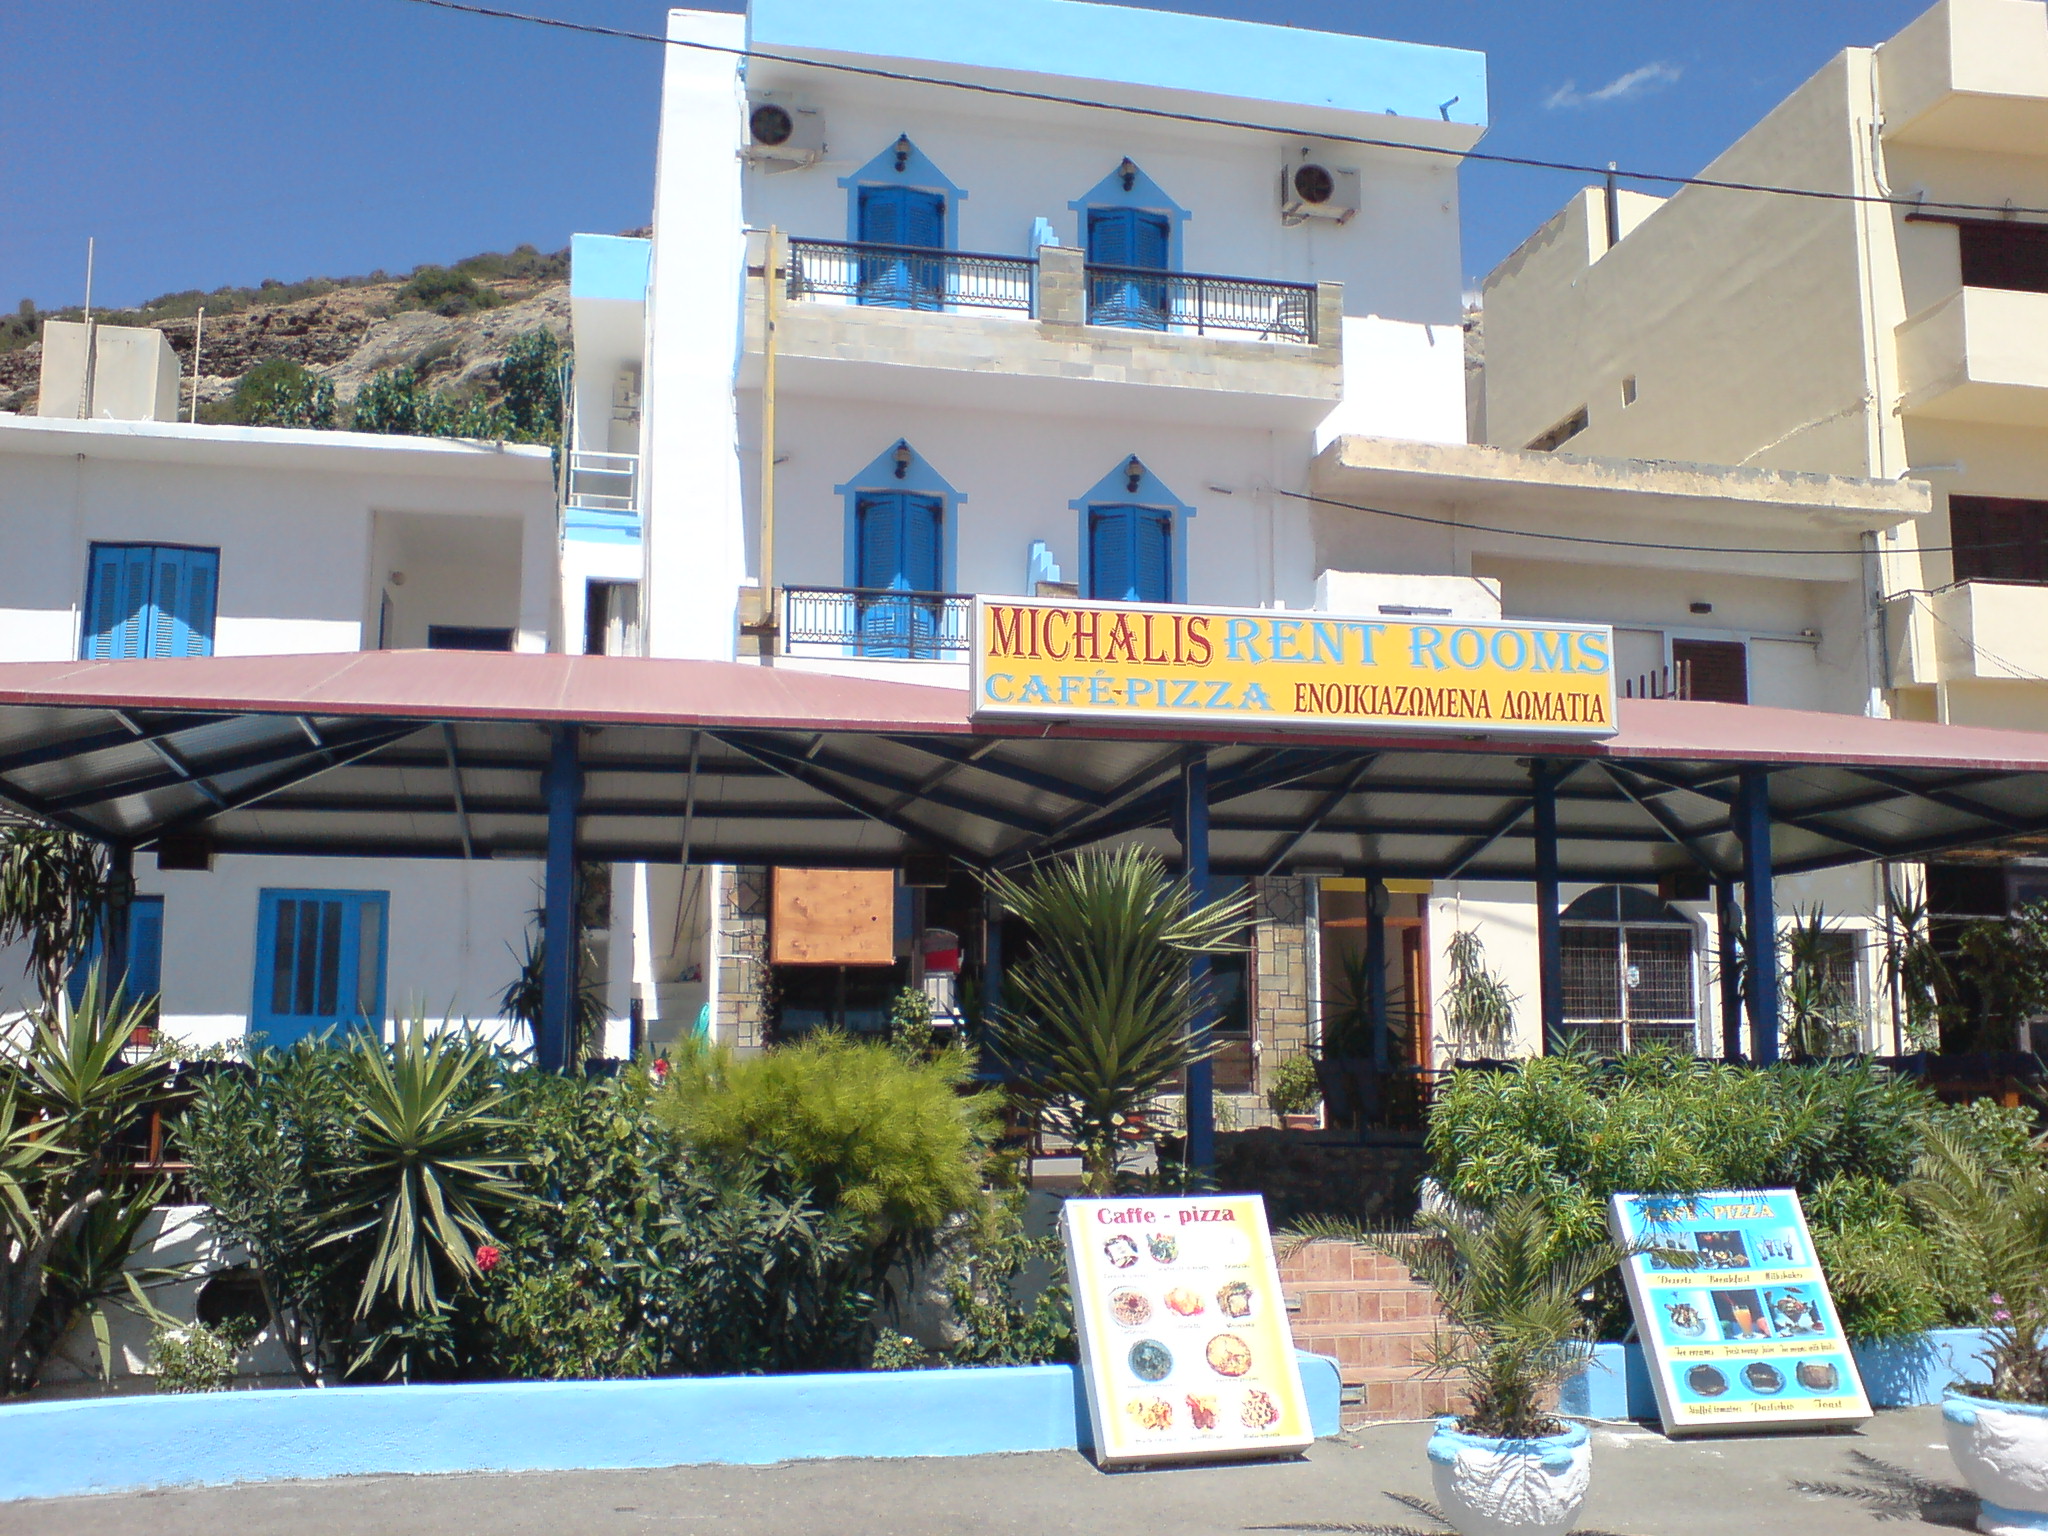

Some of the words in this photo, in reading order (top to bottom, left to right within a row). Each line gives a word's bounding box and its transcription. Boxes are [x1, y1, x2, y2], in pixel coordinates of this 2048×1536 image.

[988, 606, 1213, 667] MICHALIS
[1225, 618, 1386, 665] RENT
[1409, 627, 1610, 675] ROOMS
[1501, 690, 1605, 723] ΔΩΜΑΤΙΑ
[1097, 1207, 1156, 1225] Caffe
[1179, 1206, 1235, 1225] pizza
[1713, 1204, 1775, 1220] PIZZA
